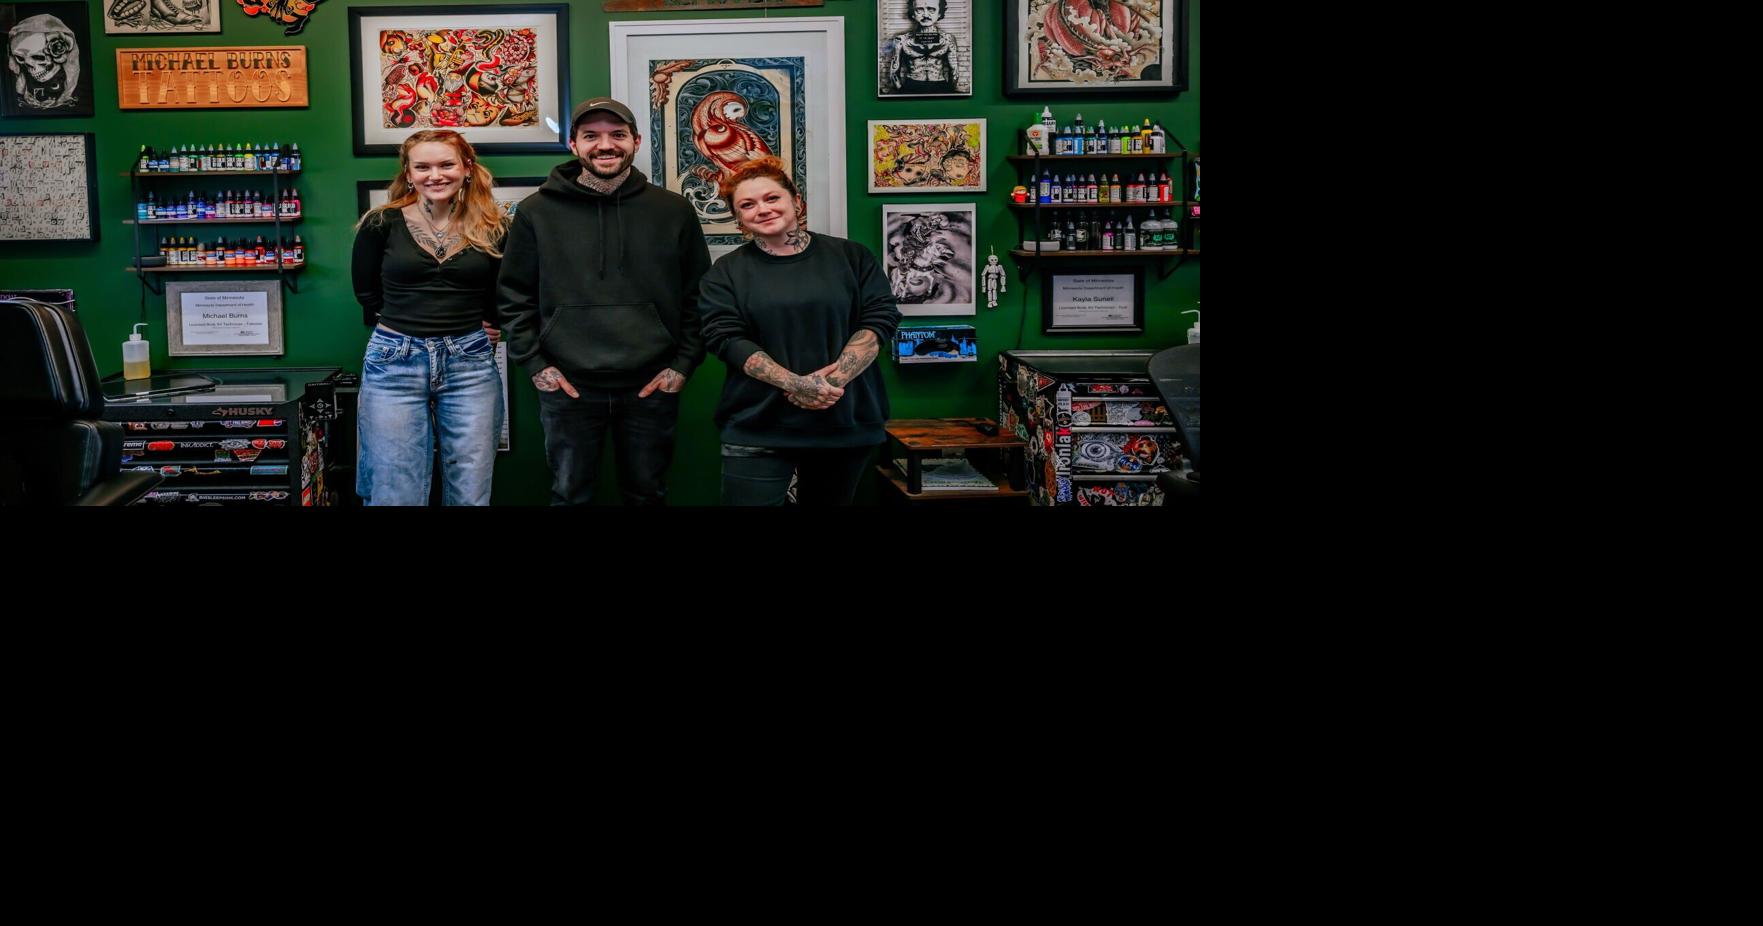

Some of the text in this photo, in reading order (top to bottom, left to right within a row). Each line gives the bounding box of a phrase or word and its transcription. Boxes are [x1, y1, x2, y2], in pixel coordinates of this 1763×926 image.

[131, 51, 292, 71] MICHAEL BURNS
[131, 70, 292, 104] TATTOOS
[228, 407, 273, 416] HUSKY
